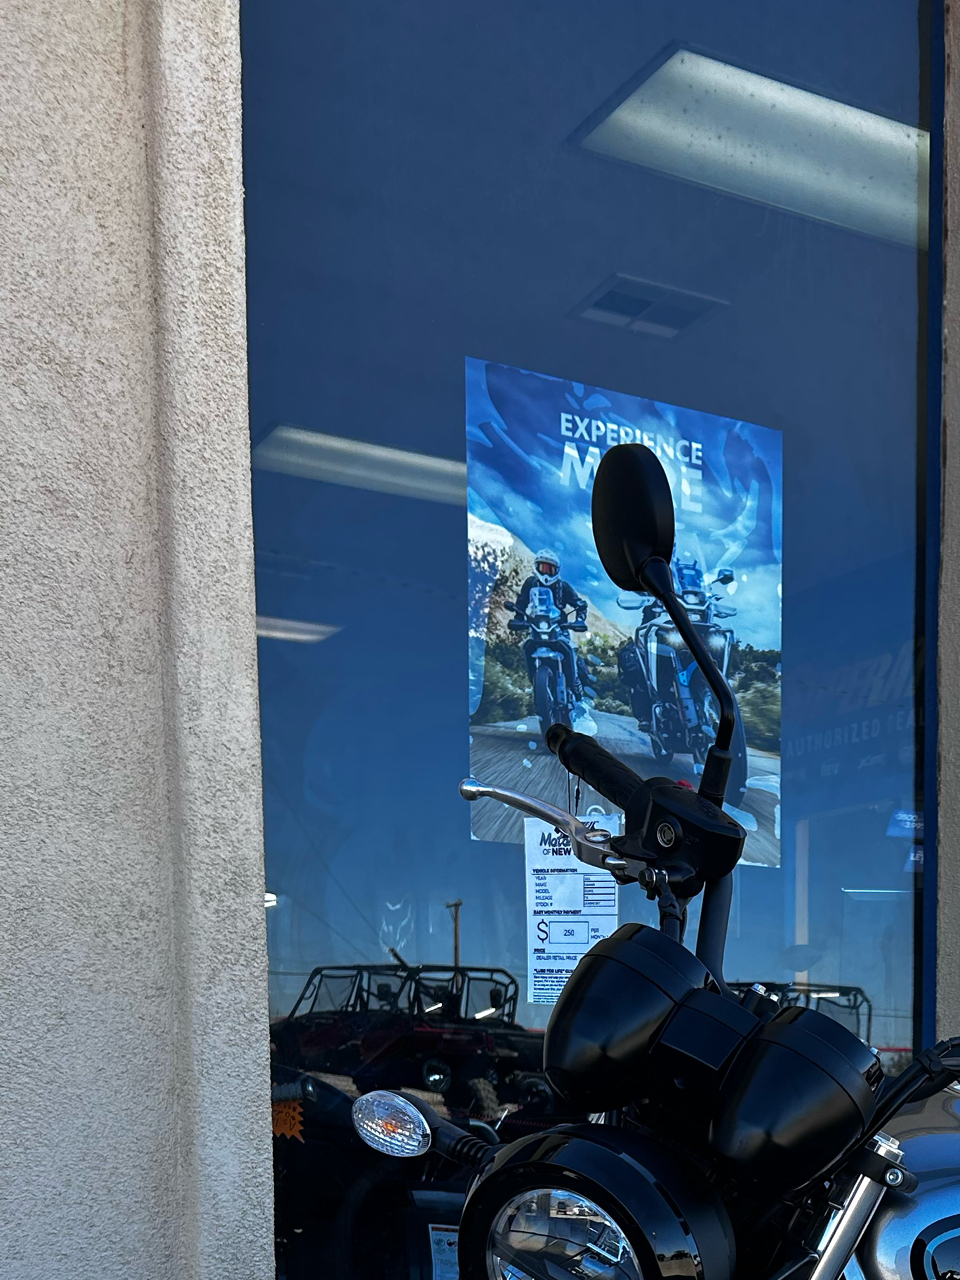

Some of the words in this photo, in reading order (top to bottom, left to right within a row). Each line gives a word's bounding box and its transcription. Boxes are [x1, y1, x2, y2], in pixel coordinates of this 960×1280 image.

[560, 412, 703, 465] EXPERIENCE
[559, 441, 703, 514] ME
[551, 848, 572, 856] NEW
[537, 918, 549, 943] $
